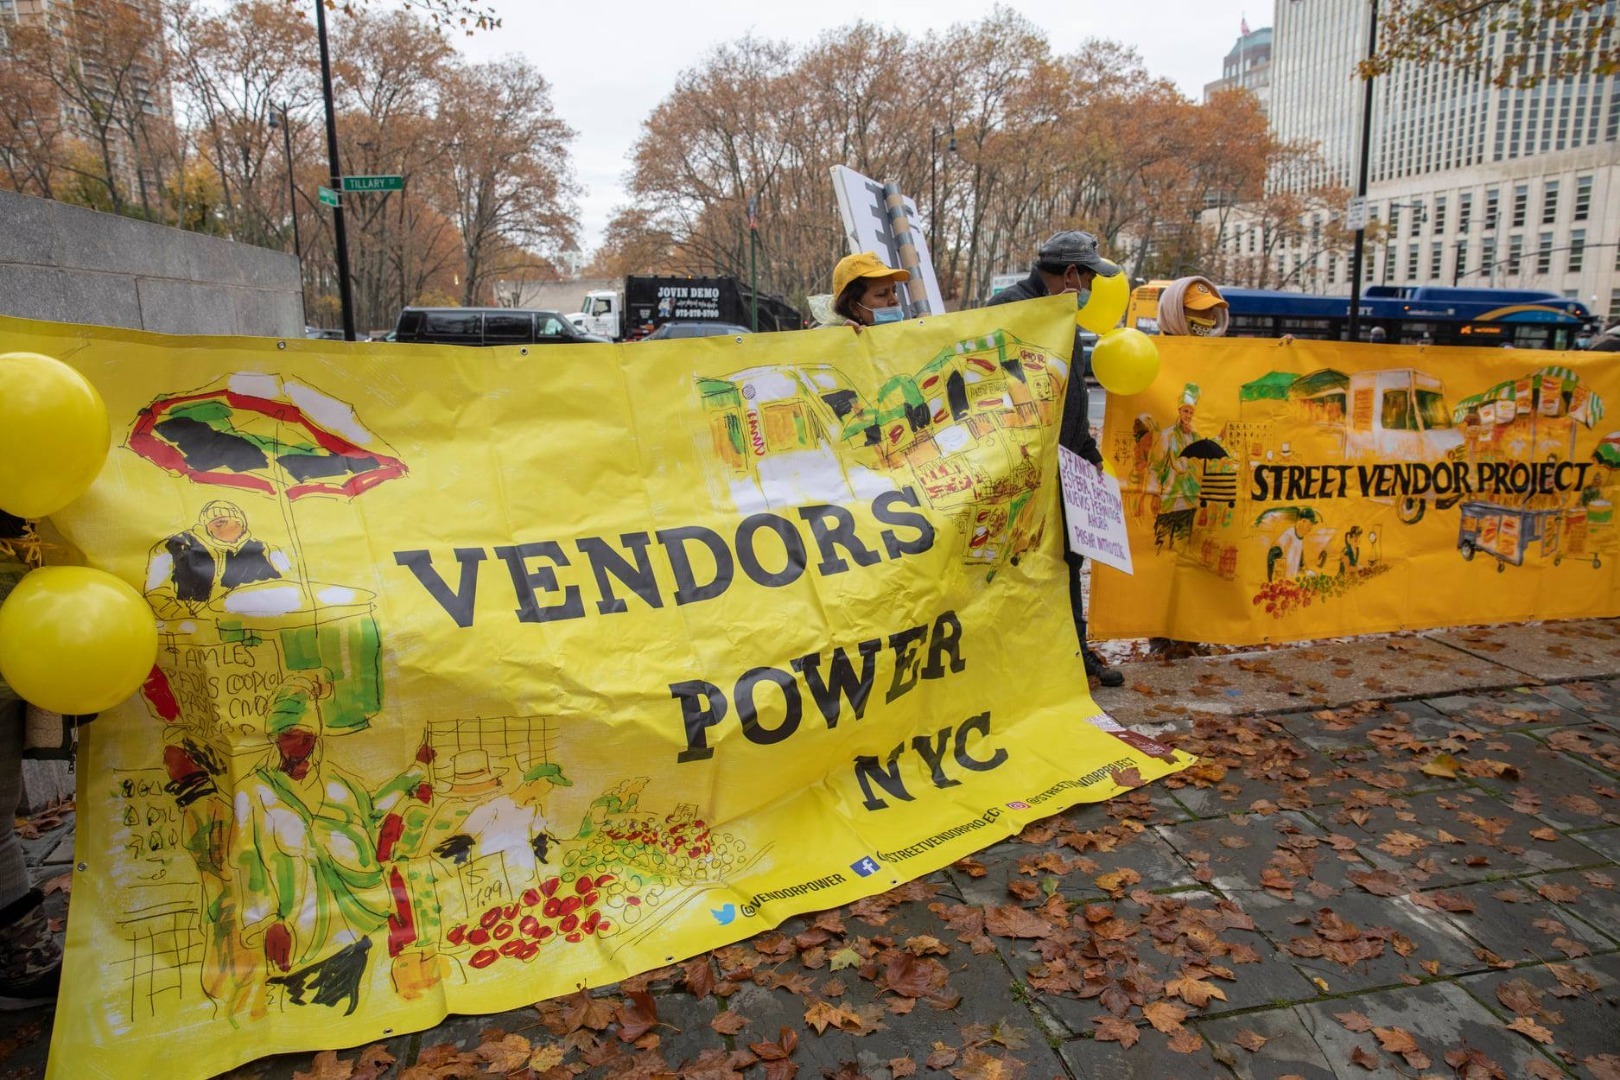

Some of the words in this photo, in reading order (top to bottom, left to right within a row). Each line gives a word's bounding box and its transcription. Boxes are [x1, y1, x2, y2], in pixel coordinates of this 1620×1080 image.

[350, 179, 385, 189] TILLARY
[657, 287, 688, 298] JOVIN
[690, 287, 719, 298] DEMO
[1060, 447, 1073, 469] 37
[1251, 464, 1353, 501] STREET
[1357, 462, 1471, 498] VENDOR
[1477, 462, 1593, 504] PROJECT
[394, 486, 935, 628] VENDORS
[668, 610, 966, 763] POWER
[853, 711, 1008, 811] NYC
[740, 873, 847, 917] @VENDORPOWER
